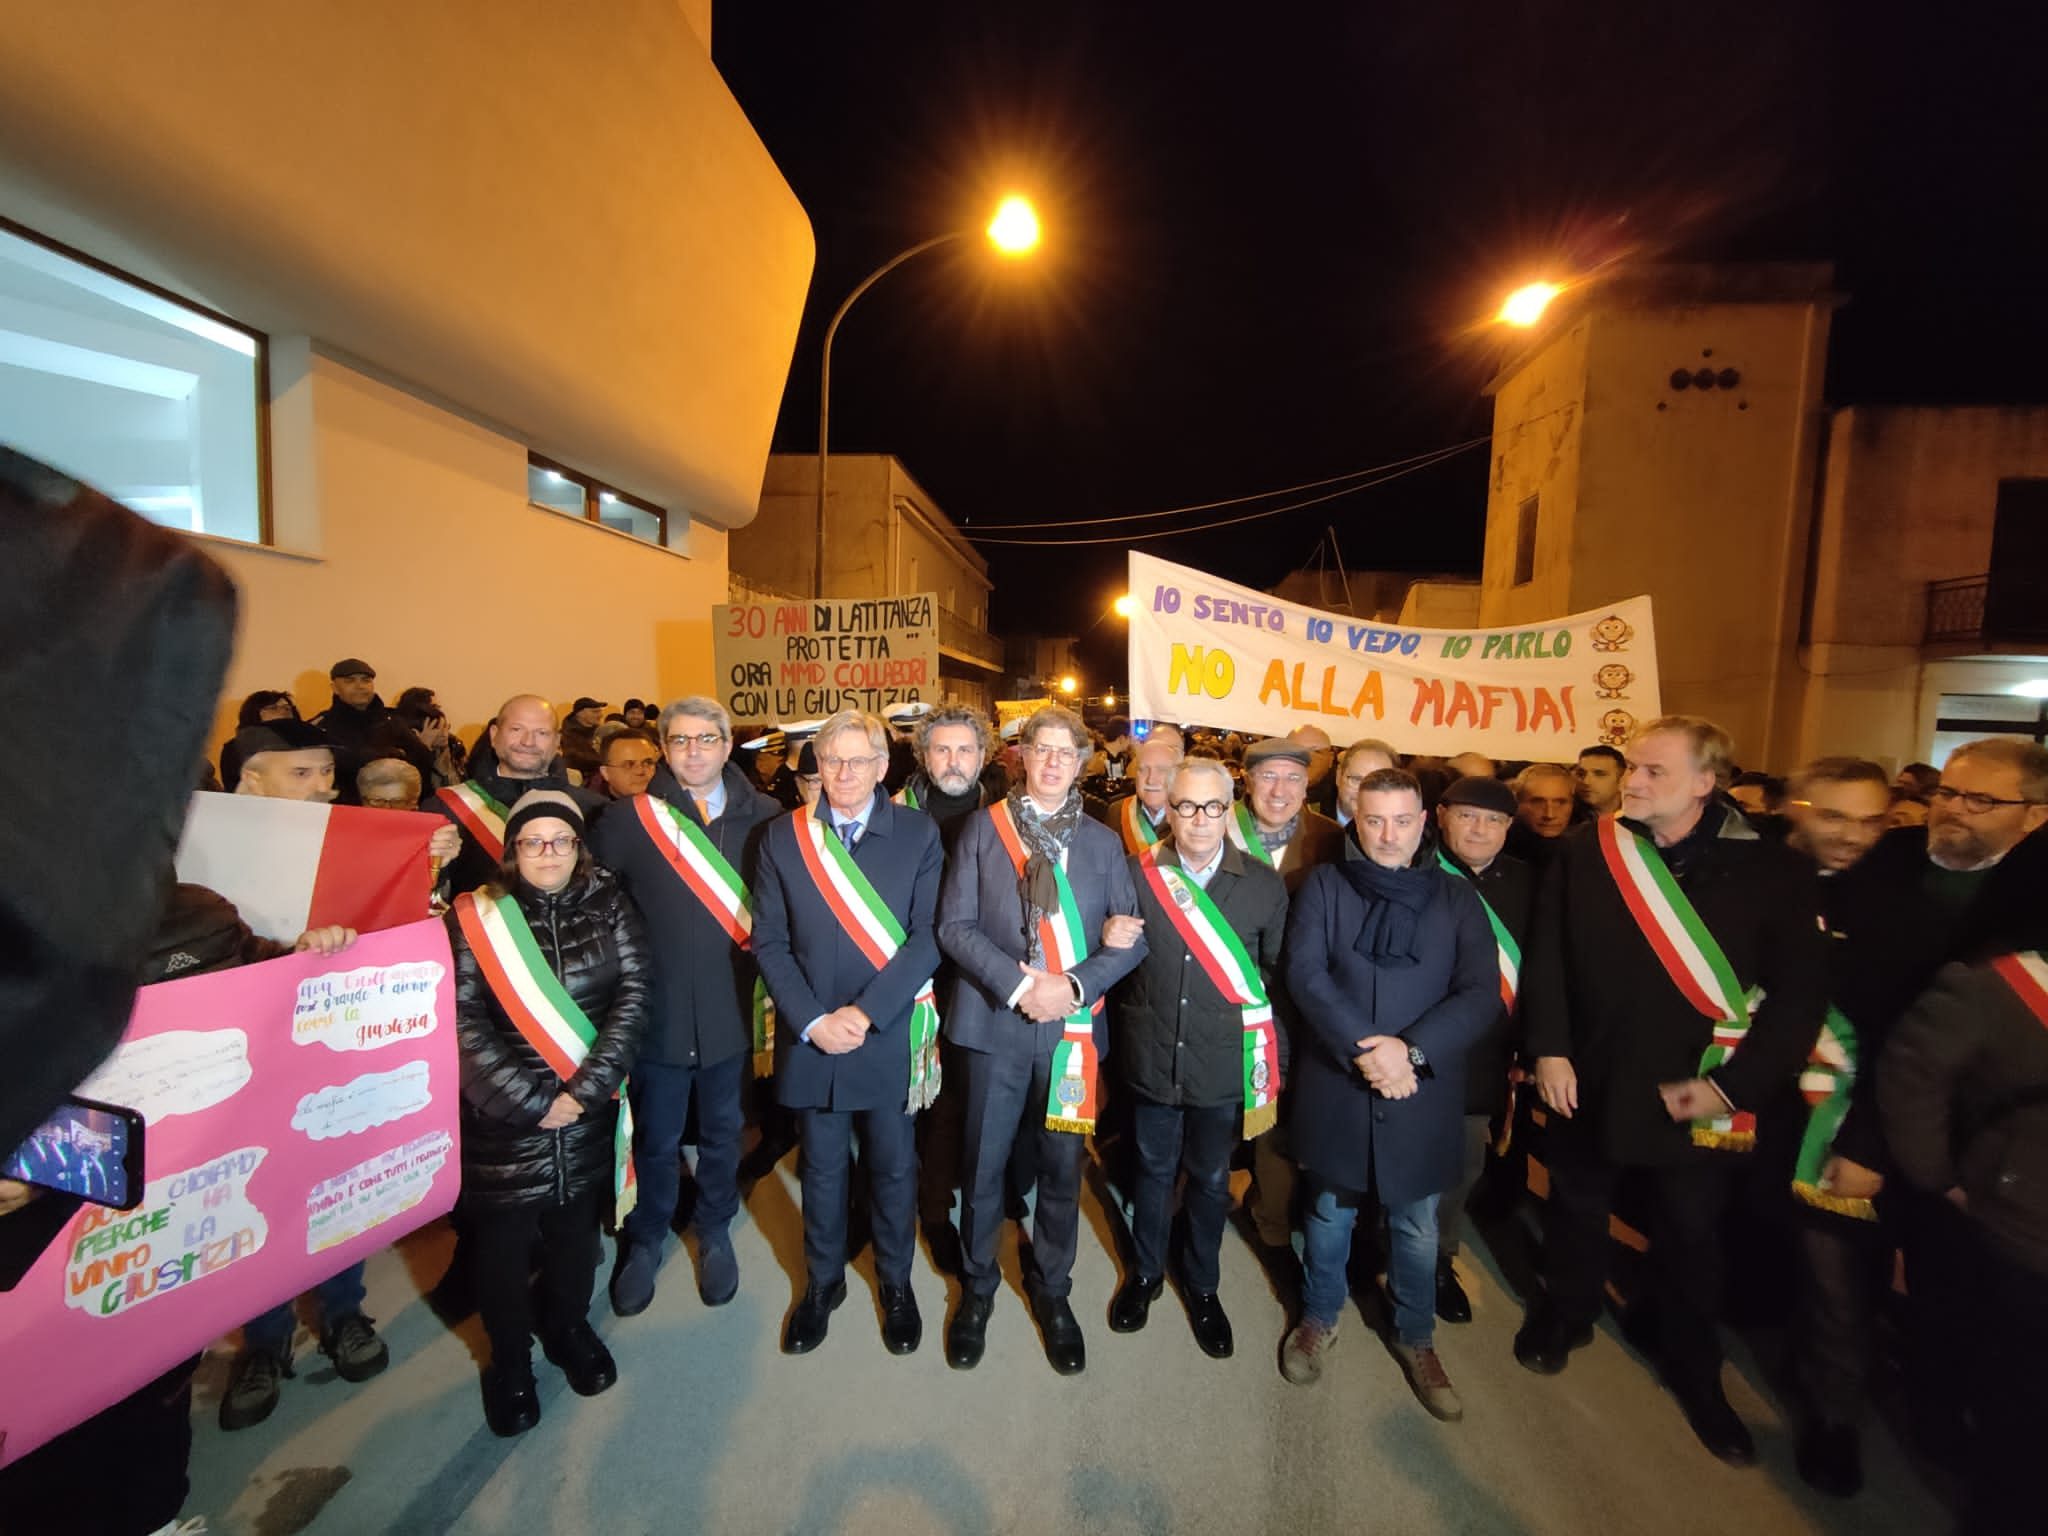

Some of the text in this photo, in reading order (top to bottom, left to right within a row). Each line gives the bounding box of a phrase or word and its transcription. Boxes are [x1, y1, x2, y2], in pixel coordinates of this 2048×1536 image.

[728, 597, 931, 639] 30 ANNI DI LATITANZA
[1154, 585, 1181, 614] IO
[1194, 595, 1285, 631] SENTO
[1306, 617, 1333, 643] IO
[1440, 636, 1472, 659] IO
[1481, 630, 1572, 659] PARLO
[786, 635, 890, 662] PROTETTA
[731, 662, 772, 687] ORA
[1167, 643, 1576, 734] NO ALLA MAFIA!
[730, 691, 768, 716] CON
[776, 689, 796, 715] LA
[101, 1227, 255, 1314] GIUSTIZIA
